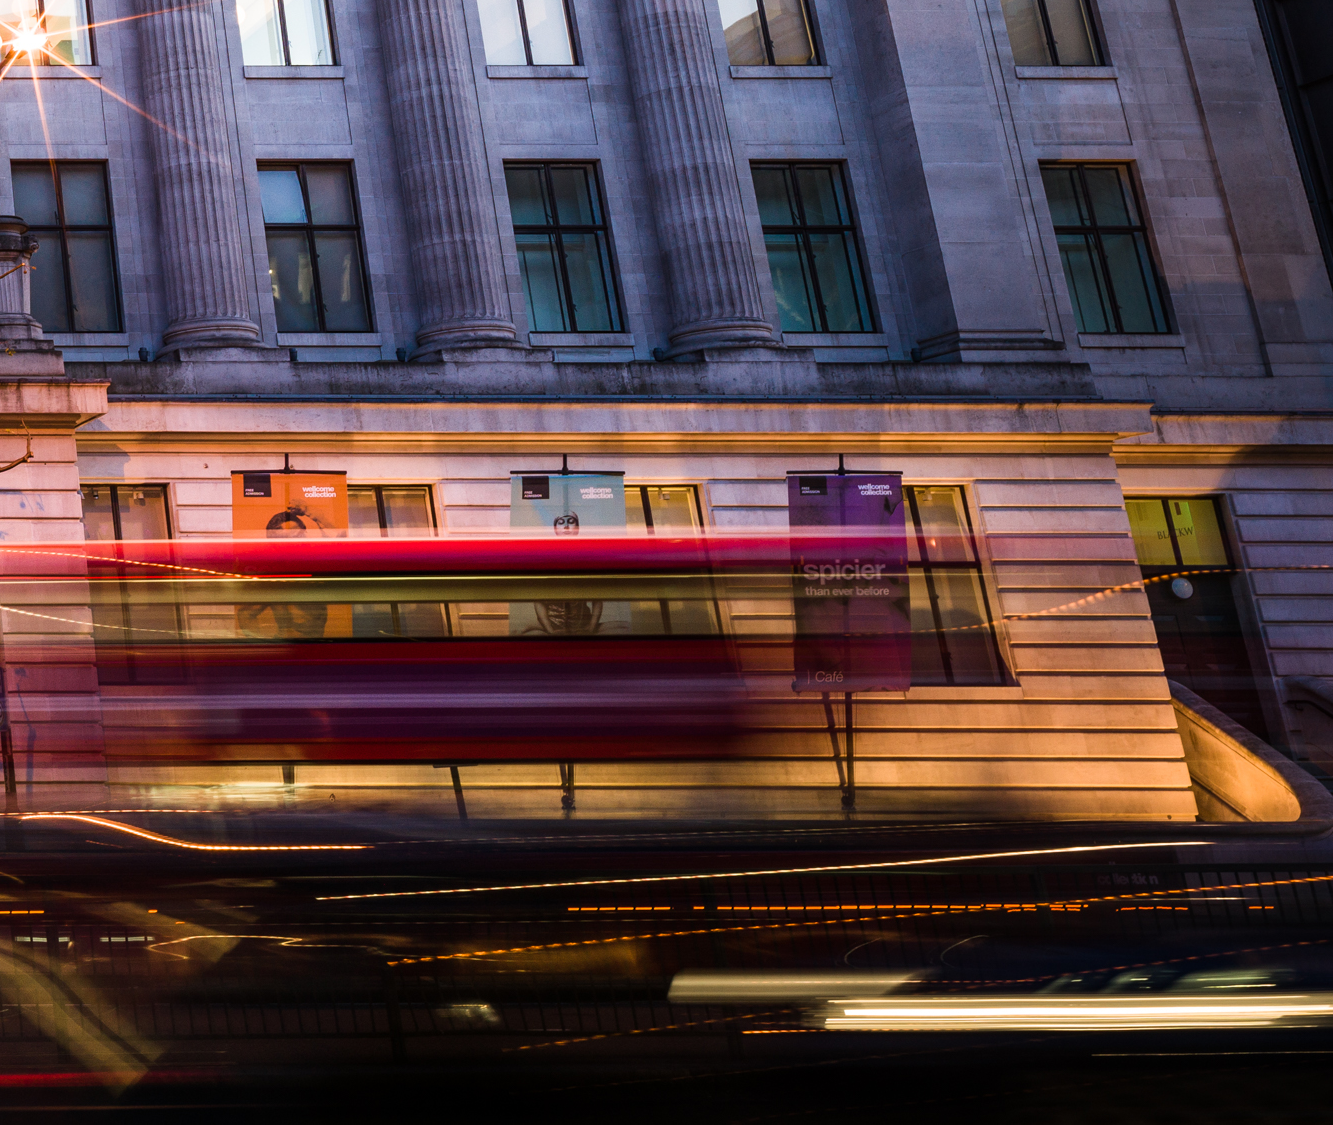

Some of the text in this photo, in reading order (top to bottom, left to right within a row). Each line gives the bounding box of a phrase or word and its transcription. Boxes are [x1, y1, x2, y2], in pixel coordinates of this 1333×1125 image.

[1156, 526, 1194, 540] BLCKW
[803, 559, 886, 585] spicier
[805, 586, 890, 596] than ever before
[815, 670, 844, 683] Café
